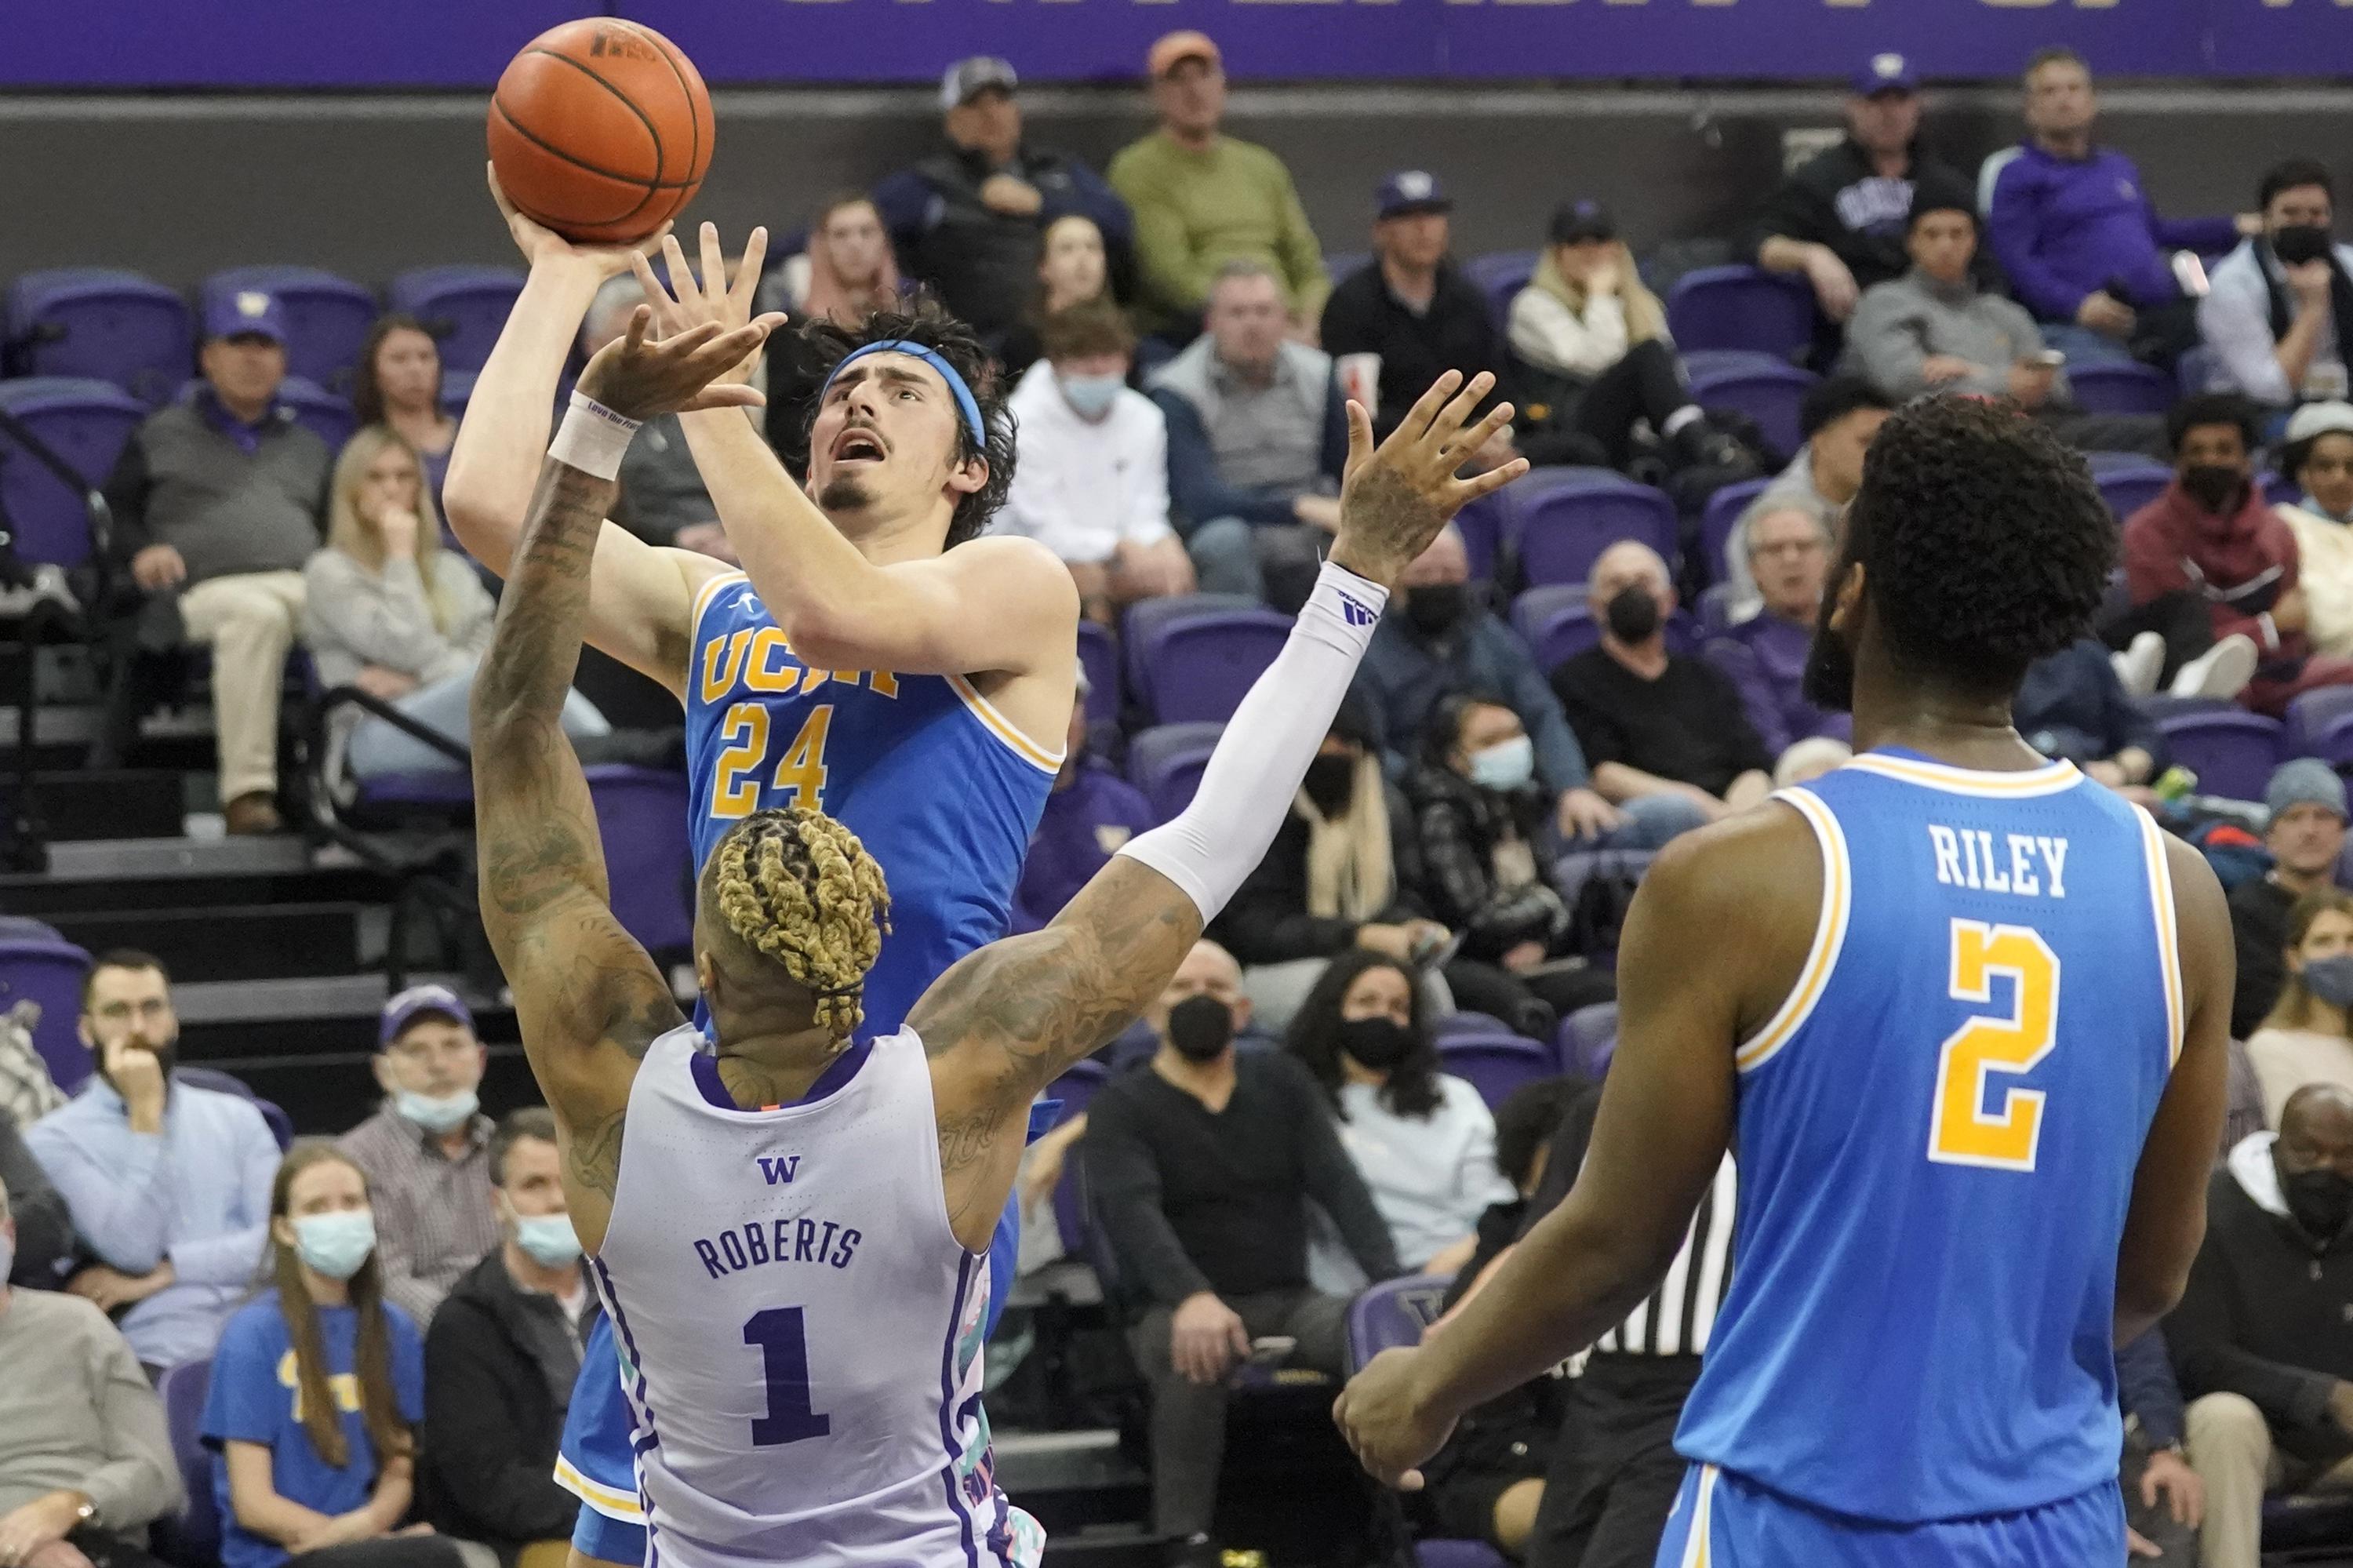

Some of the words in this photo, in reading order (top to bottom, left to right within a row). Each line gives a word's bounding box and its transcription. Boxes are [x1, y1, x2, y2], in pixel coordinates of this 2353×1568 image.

[709, 702, 835, 819] 24
[1928, 824, 2069, 899] RILEY
[1927, 916, 2061, 1173] 2
[756, 1155, 802, 1186] W
[693, 1217, 863, 1279] ROBERTS
[743, 1305, 831, 1446] 1
